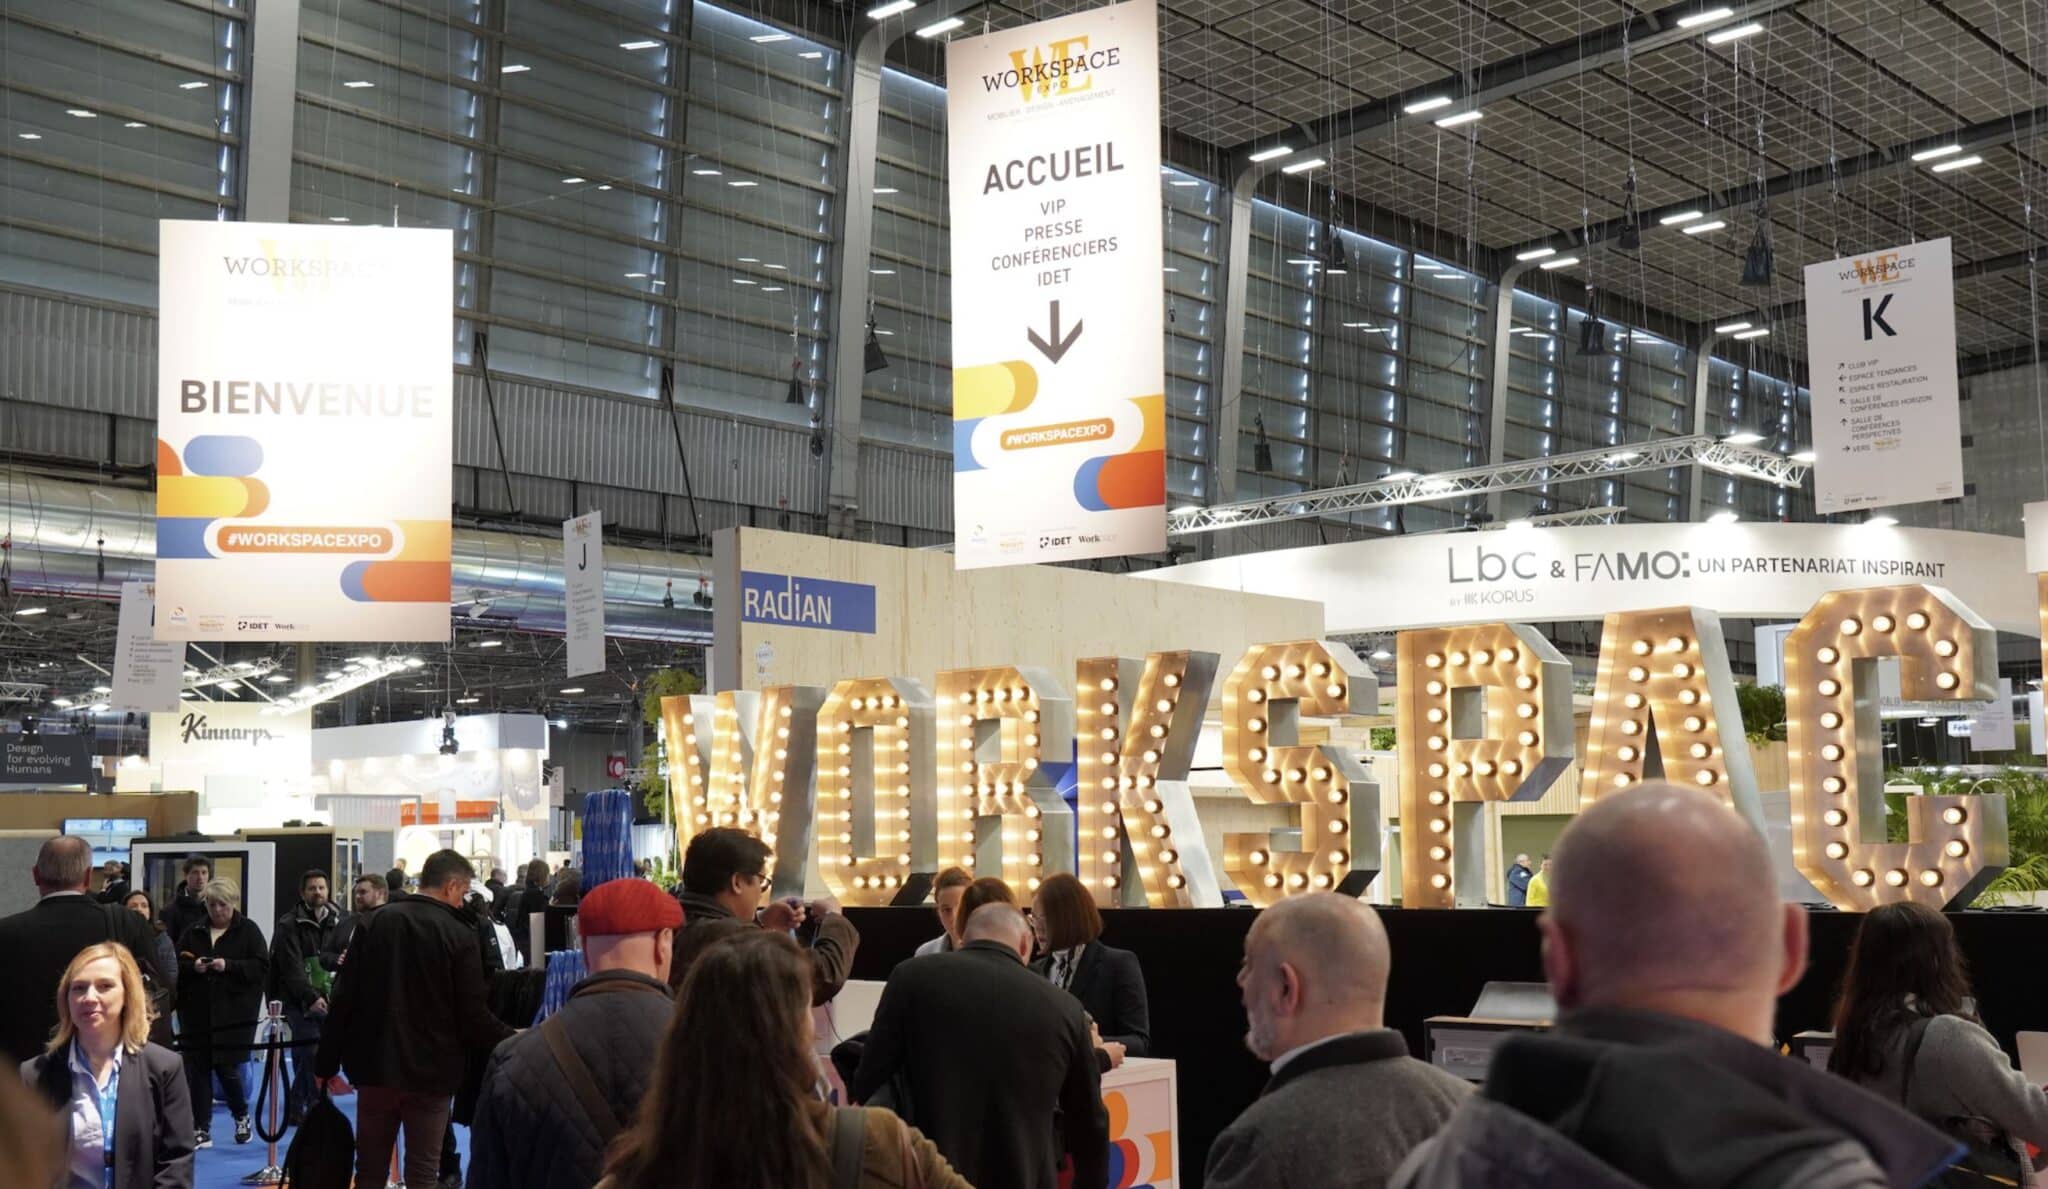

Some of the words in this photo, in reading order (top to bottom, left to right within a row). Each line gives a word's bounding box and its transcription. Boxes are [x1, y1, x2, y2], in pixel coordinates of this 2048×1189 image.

[982, 47, 1121, 93] WORKSPACE
[983, 141, 1124, 195] ACCUEIL
[1040, 199, 1066, 216] VIP
[1024, 218, 1083, 242] PRESSE
[991, 237, 1118, 271] CONFÉRENCIERS
[223, 256, 385, 278] WORKSPA
[1037, 268, 1071, 287] IDET
[1839, 258, 1916, 281] WORKSPACE
[1862, 293, 1897, 341] K
[1849, 371, 1874, 382] ESPACE
[1876, 364, 1918, 377] TENDANCES
[180, 379, 433, 418] BIENVENUE
[1849, 383, 1875, 393] ESPACE
[1006, 423, 1107, 446] #WORKSPACEXPO
[227, 531, 382, 548] #WORKSPACEXPO
[1051, 536, 1072, 546] IDET
[578, 543, 587, 571] J
[1448, 546, 1537, 583] Lbc
[1550, 560, 1565, 578] &
[1698, 558, 1726, 573] UN
[1732, 557, 1857, 574] PARTENARIAT
[1862, 560, 1946, 578] INSPIRANT
[1480, 588, 1535, 604] KORUS
[250, 622, 268, 630] IDET
[181, 712, 282, 747] Kinnarps
[6, 743, 44, 755] Design
[660, 575, 2048, 912] WORKSPAC
[6, 764, 52, 774] Humans
[7, 754, 23, 764] for
[26, 754, 71, 767] evolving
